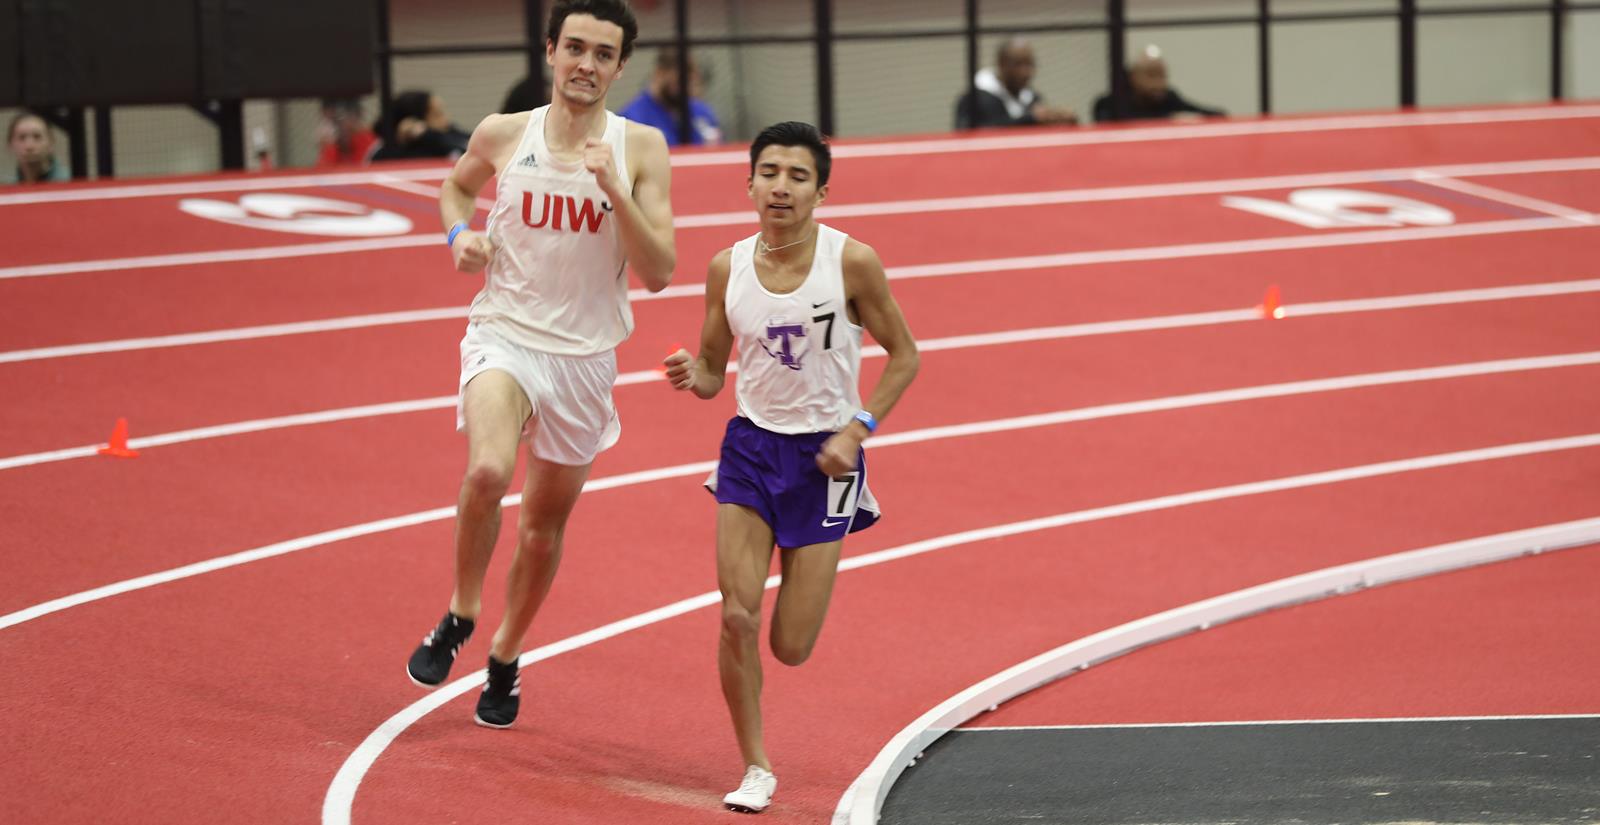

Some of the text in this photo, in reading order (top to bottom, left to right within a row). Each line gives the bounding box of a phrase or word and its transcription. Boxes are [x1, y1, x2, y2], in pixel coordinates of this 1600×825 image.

[522, 191, 604, 234] UIW
[766, 324, 805, 365] T
[812, 312, 835, 350] 7
[832, 475, 855, 513] 7
